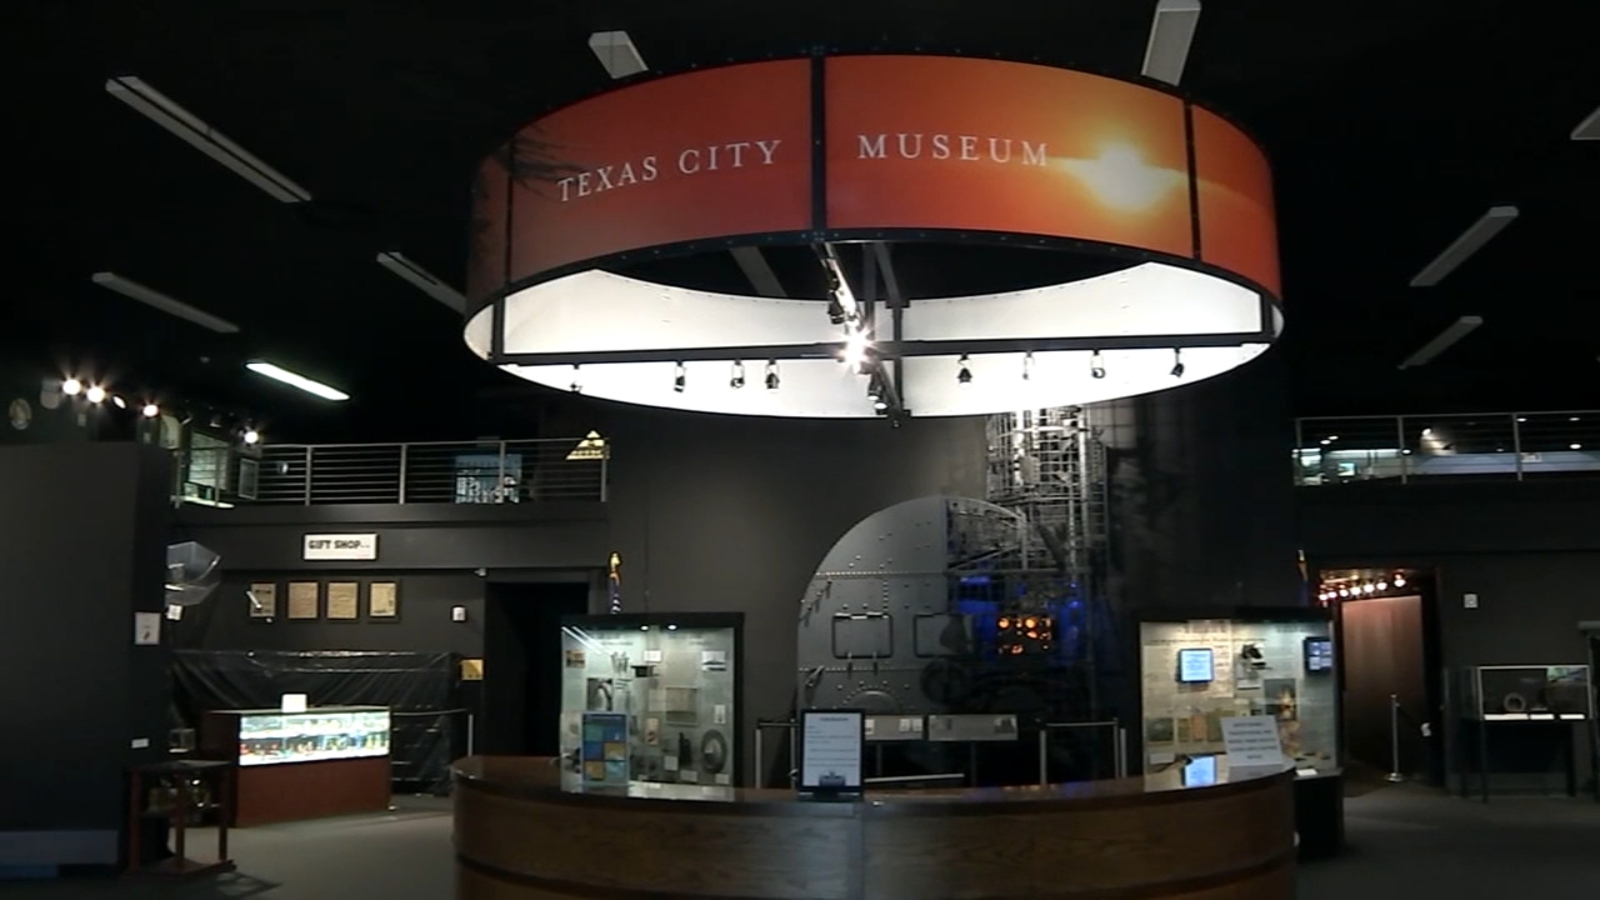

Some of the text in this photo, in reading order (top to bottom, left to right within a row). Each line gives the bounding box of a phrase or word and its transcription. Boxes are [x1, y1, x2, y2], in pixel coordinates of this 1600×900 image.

[557, 133, 1048, 202] TEXAS CITY MUSEUM
[309, 540, 361, 550] GIFT SHOP
